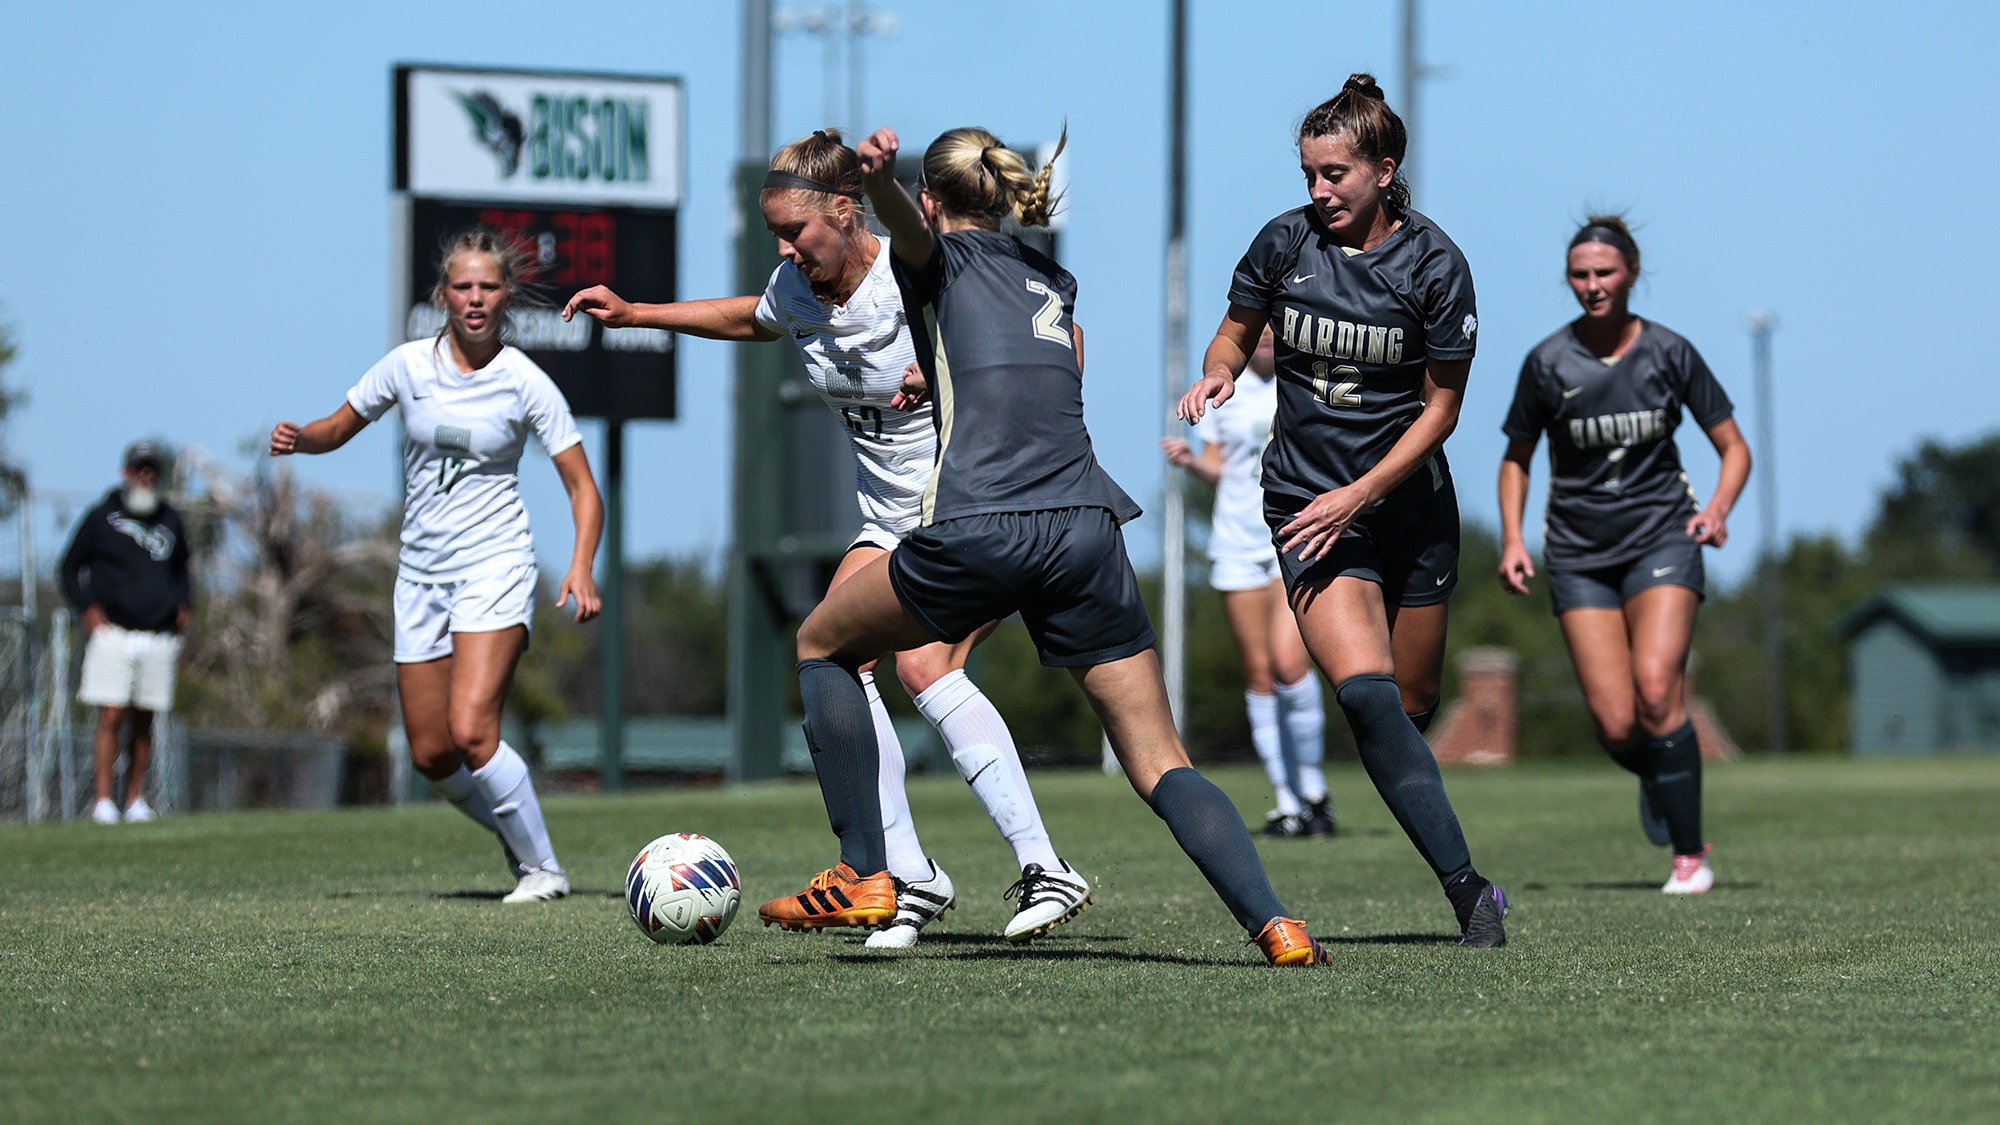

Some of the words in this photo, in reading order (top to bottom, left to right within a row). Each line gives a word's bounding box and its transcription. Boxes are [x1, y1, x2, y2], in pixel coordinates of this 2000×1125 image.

[531, 93, 650, 180] BISON
[1024, 278, 1072, 350] 2
[1282, 306, 1404, 365] HARDING
[1311, 360, 1363, 408] 12
[1568, 408, 1667, 449] HARDING
